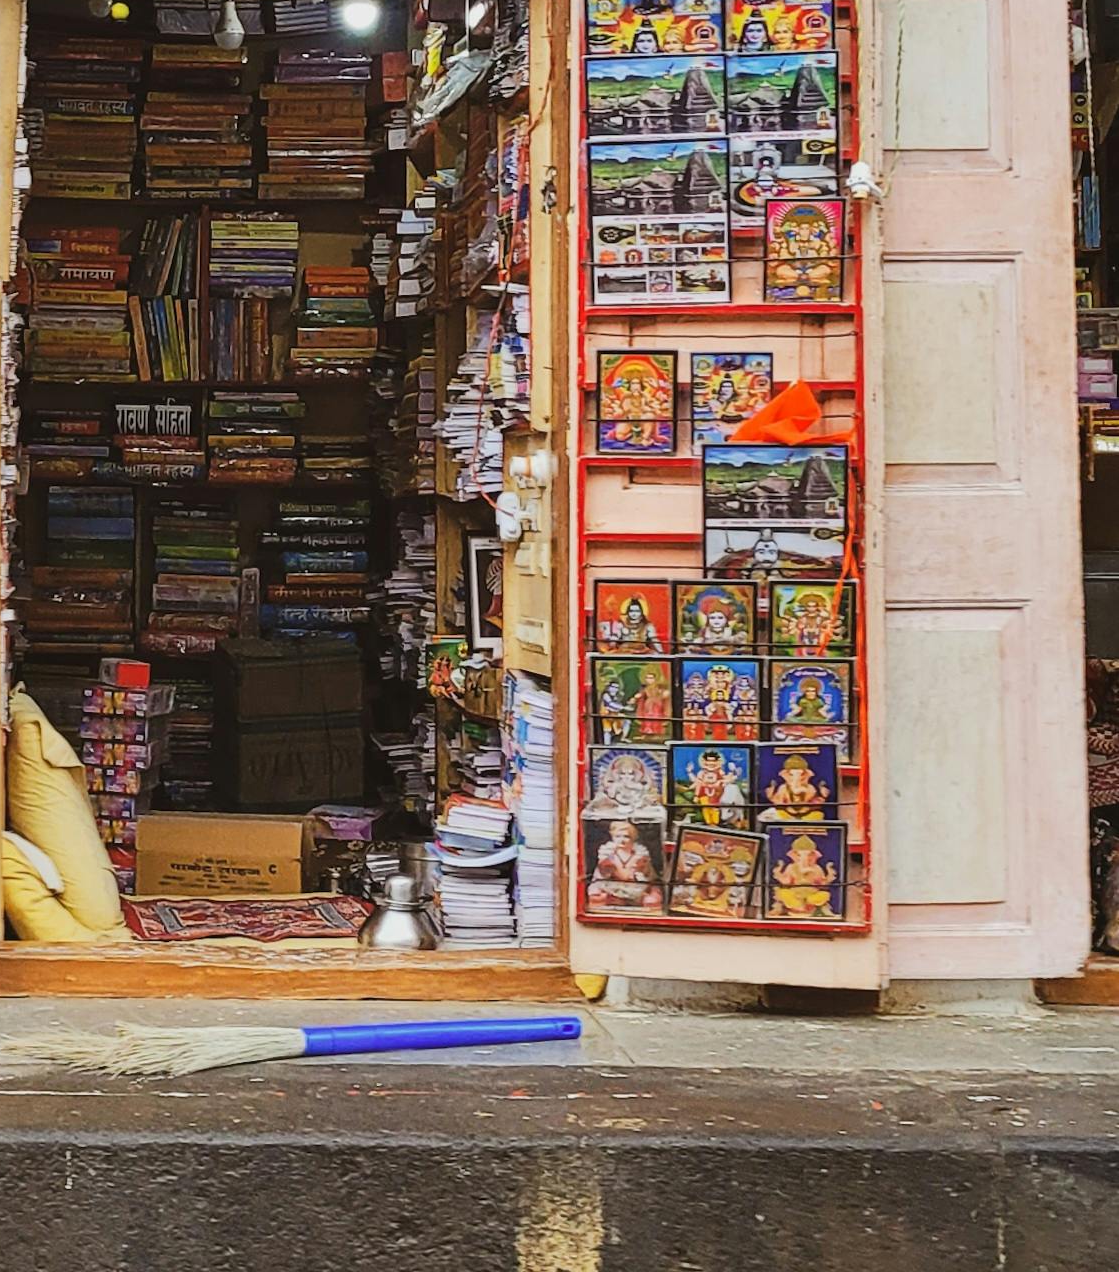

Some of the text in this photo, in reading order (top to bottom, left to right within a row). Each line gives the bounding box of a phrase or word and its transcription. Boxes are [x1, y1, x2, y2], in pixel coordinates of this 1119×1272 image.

[58, 267, 116, 281] रामायण
[115, 404, 151, 434] रावण
[268, 864, 277, 874] C
